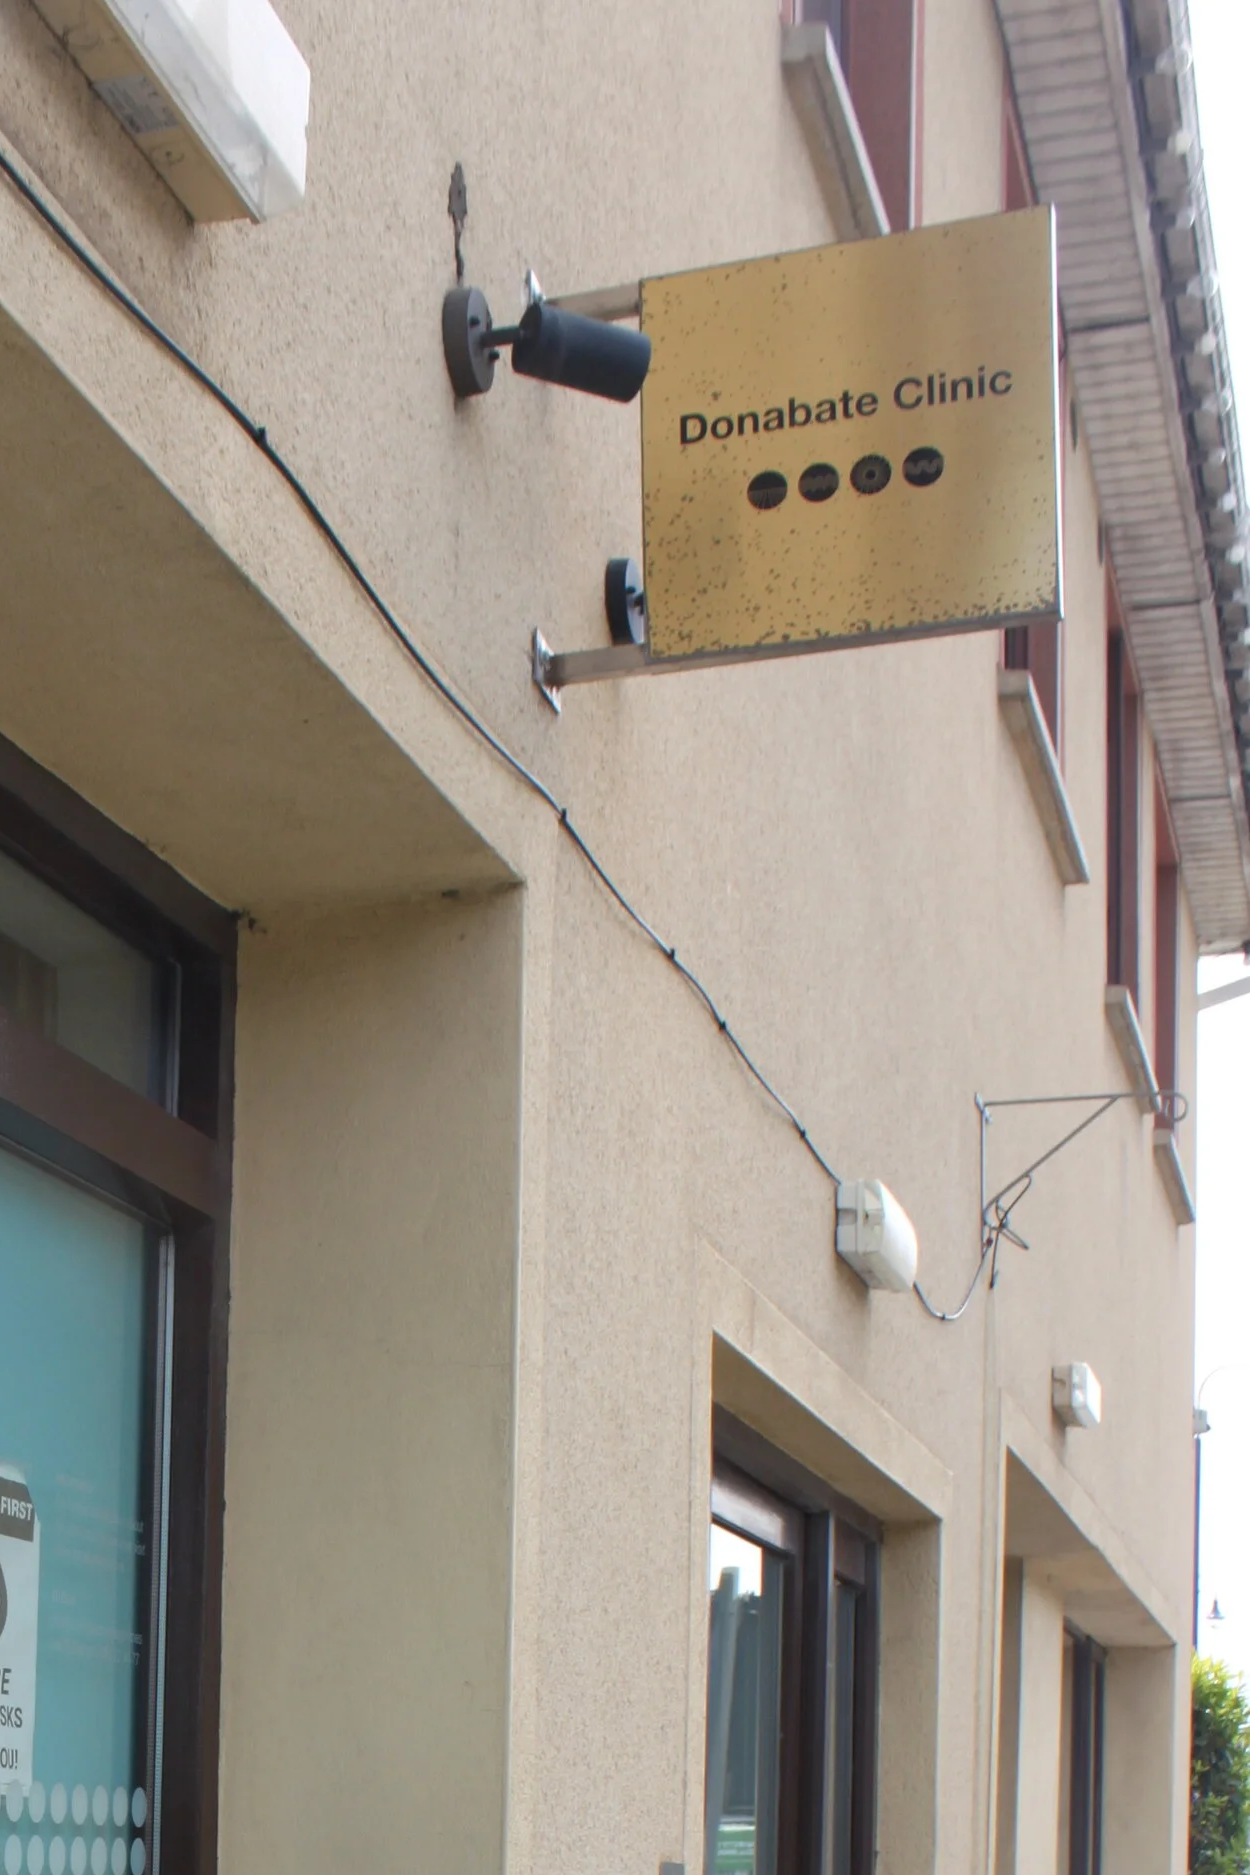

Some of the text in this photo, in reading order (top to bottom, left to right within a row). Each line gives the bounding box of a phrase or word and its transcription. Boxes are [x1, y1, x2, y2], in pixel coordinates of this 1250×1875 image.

[679, 365, 1013, 446] Donabate Clinic
[1, 1496, 33, 1521] FIRST
